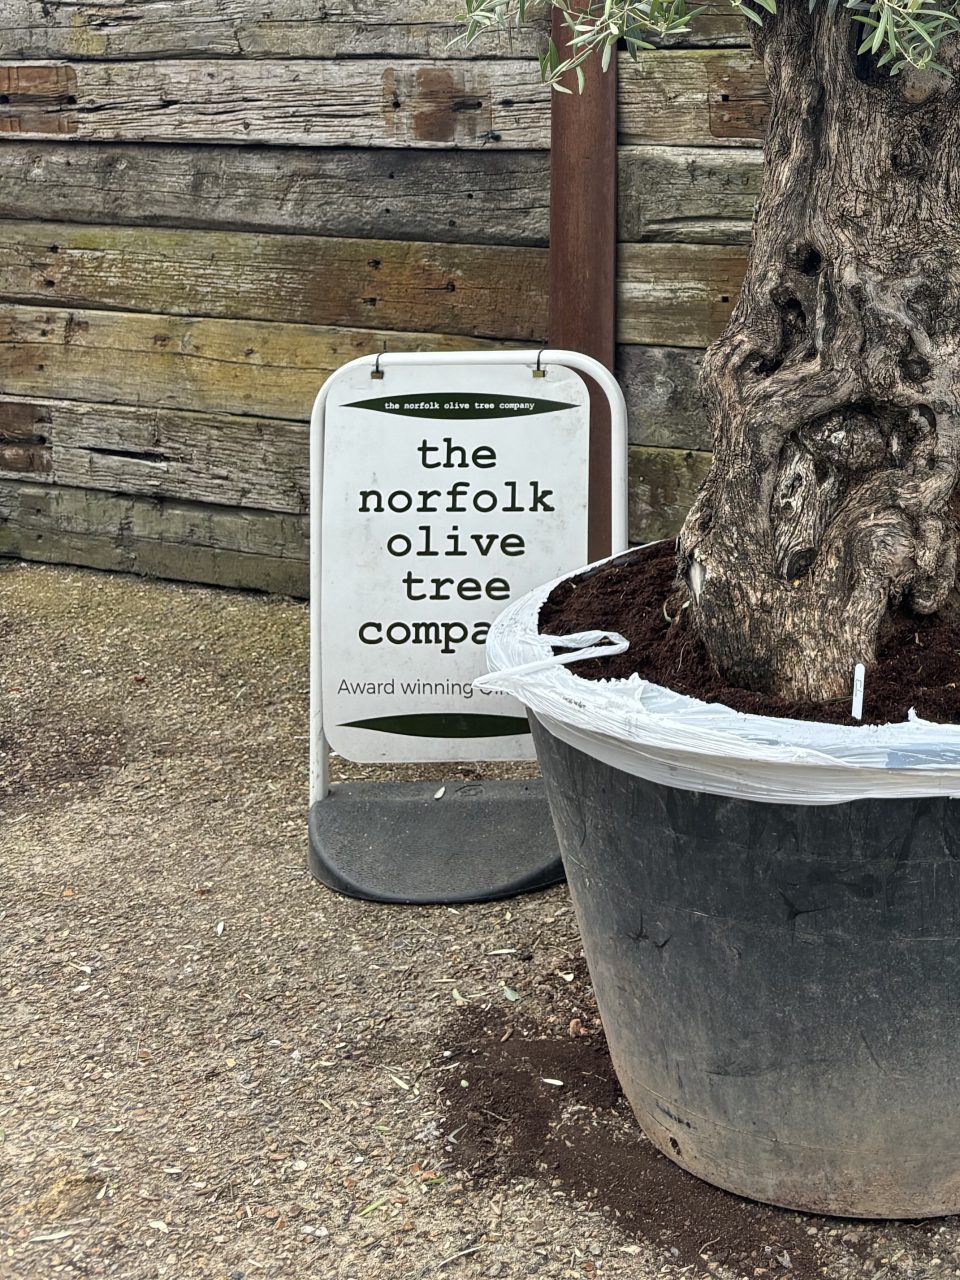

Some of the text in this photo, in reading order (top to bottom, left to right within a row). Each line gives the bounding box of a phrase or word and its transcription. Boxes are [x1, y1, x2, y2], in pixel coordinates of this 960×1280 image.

[384, 401, 535, 411] the norfolk olive tree company
[418, 438, 496, 468] the
[359, 481, 555, 513] norfolk
[387, 526, 525, 556] olive
[402, 571, 510, 600] tree
[358, 621, 491, 654] compa
[338, 679, 394, 694] Award
[401, 679, 473, 699] winning
